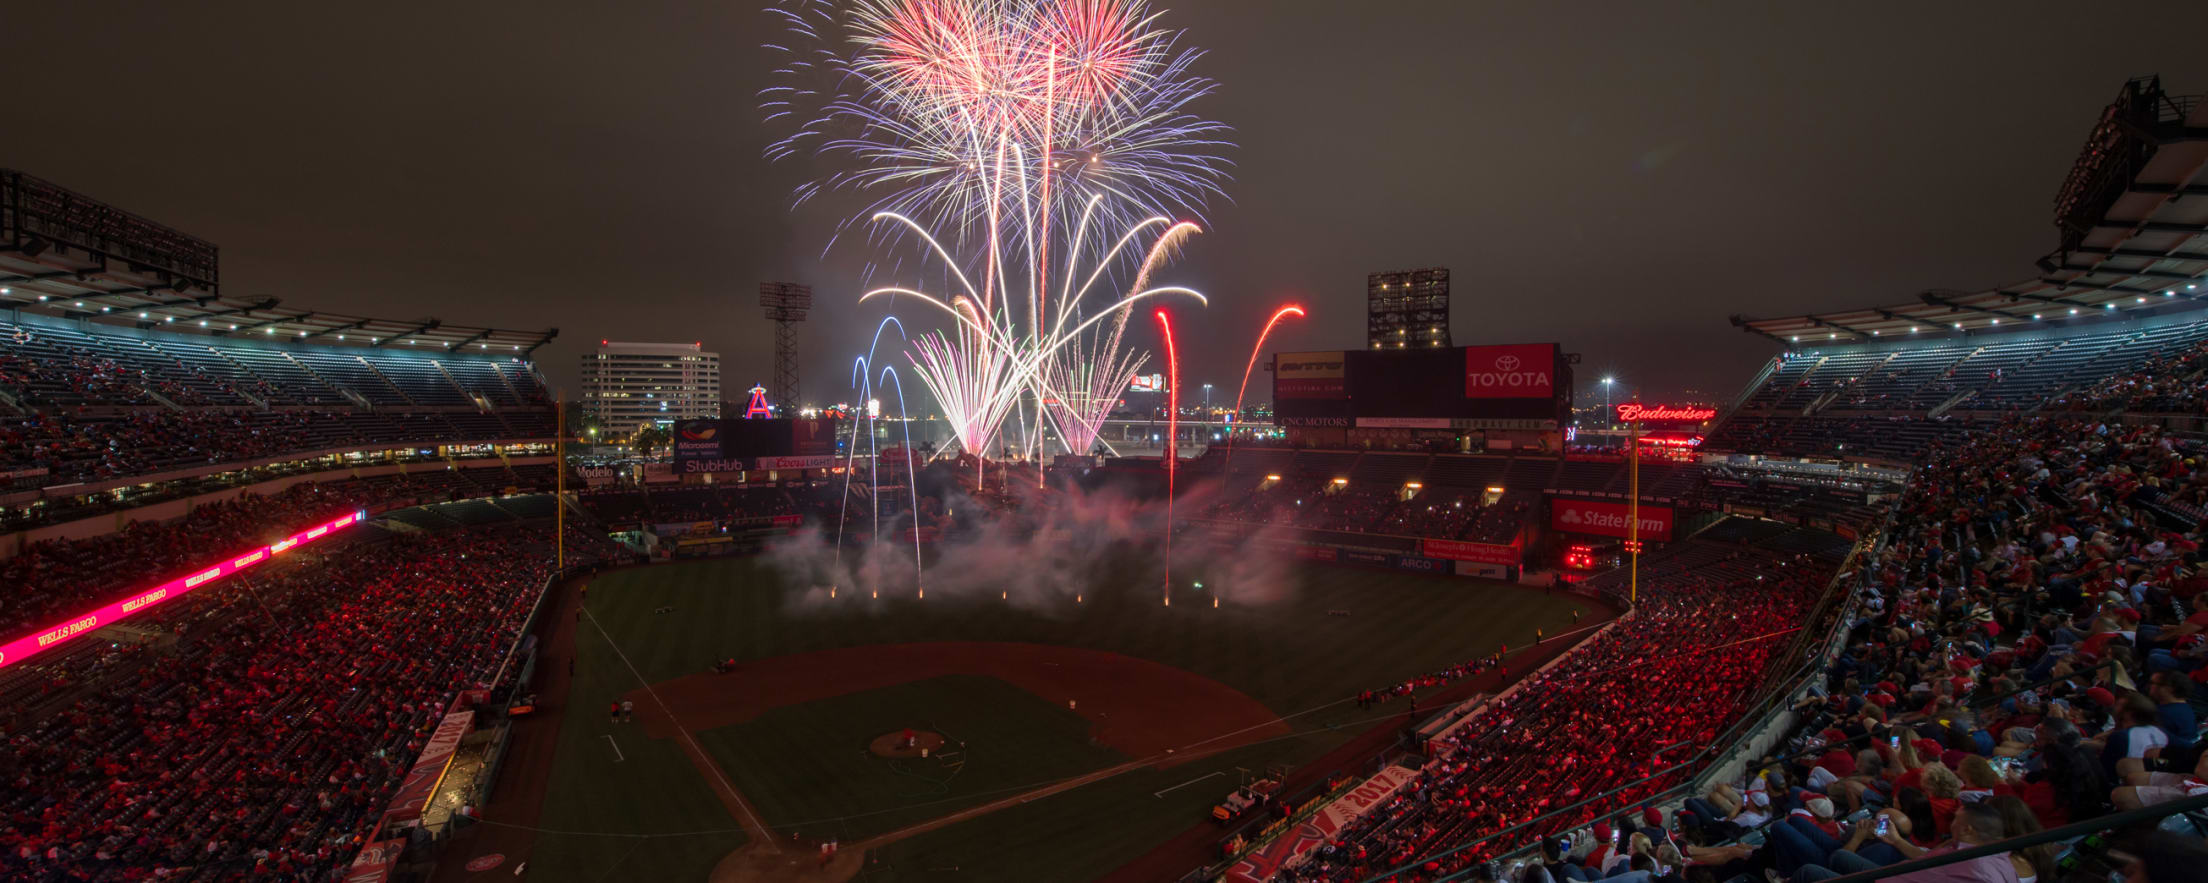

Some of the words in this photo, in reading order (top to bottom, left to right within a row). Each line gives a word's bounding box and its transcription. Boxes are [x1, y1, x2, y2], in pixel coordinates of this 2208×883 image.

[1469, 371, 1550, 388] TOYOTA
[1616, 404, 1716, 421] Budweiser
[1281, 417, 1303, 427] CNC
[1305, 417, 1349, 427] MOTORS
[678, 440, 720, 449] Microsemi
[685, 458, 743, 473] StubHub
[775, 457, 805, 468] Coors
[806, 458, 831, 467] LIGHT
[576, 465, 614, 478] Modelo
[1400, 558, 1432, 569] ARCO
[121, 595, 145, 613] WELLS
[145, 588, 167, 605] FARGO
[37, 626, 69, 647] WELLS
[69, 615, 97, 635] FARGO
[1345, 774, 1397, 808] 2017
